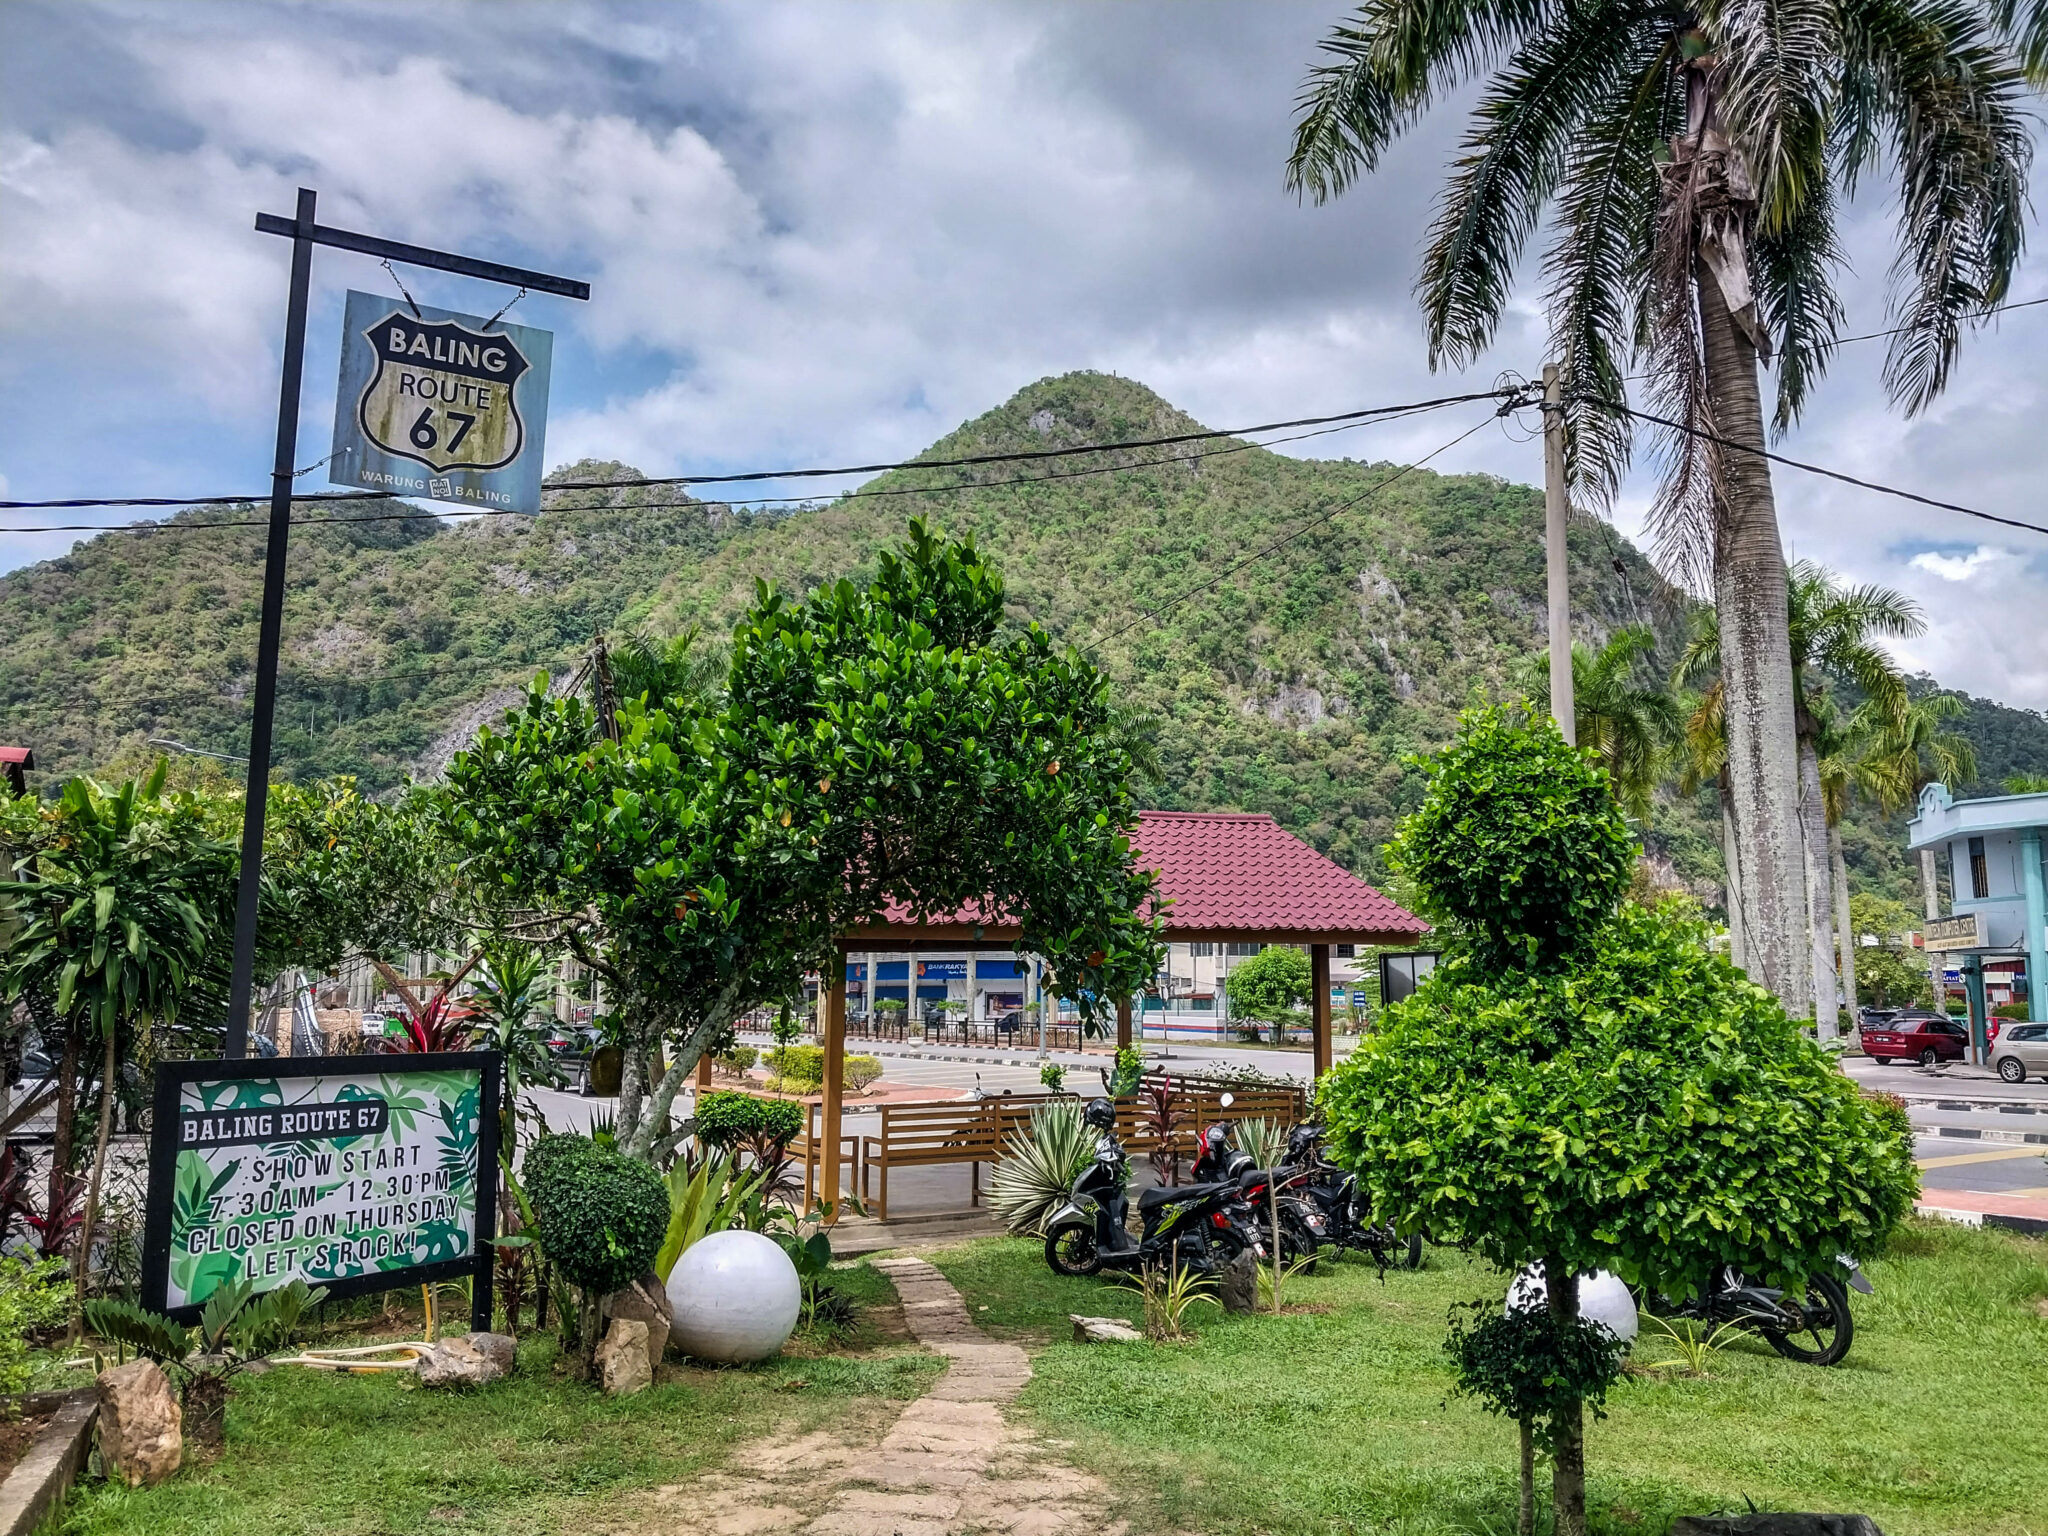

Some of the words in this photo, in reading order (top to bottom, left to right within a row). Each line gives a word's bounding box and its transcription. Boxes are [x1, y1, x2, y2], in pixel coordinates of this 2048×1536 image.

[389, 327, 508, 373] BALING
[399, 373, 491, 411] ROUTE
[409, 406, 476, 454] 67
[361, 471, 425, 490] WARUNG
[455, 486, 511, 504] BALING
[183, 1114, 272, 1143] BALING
[280, 1109, 350, 1135] ROUTE
[357, 1107, 381, 1128] 67
[251, 1152, 332, 1183] SHOW
[343, 1145, 421, 1173] START
[209, 1185, 316, 1222] 7.30AM
[347, 1168, 450, 1202] 12.30PM
[188, 1219, 294, 1256] CLOSED
[304, 1214, 337, 1239] ON
[346, 1196, 460, 1232] THURSDAY
[246, 1243, 329, 1279] LET'S
[339, 1231, 418, 1265] ROCK!
